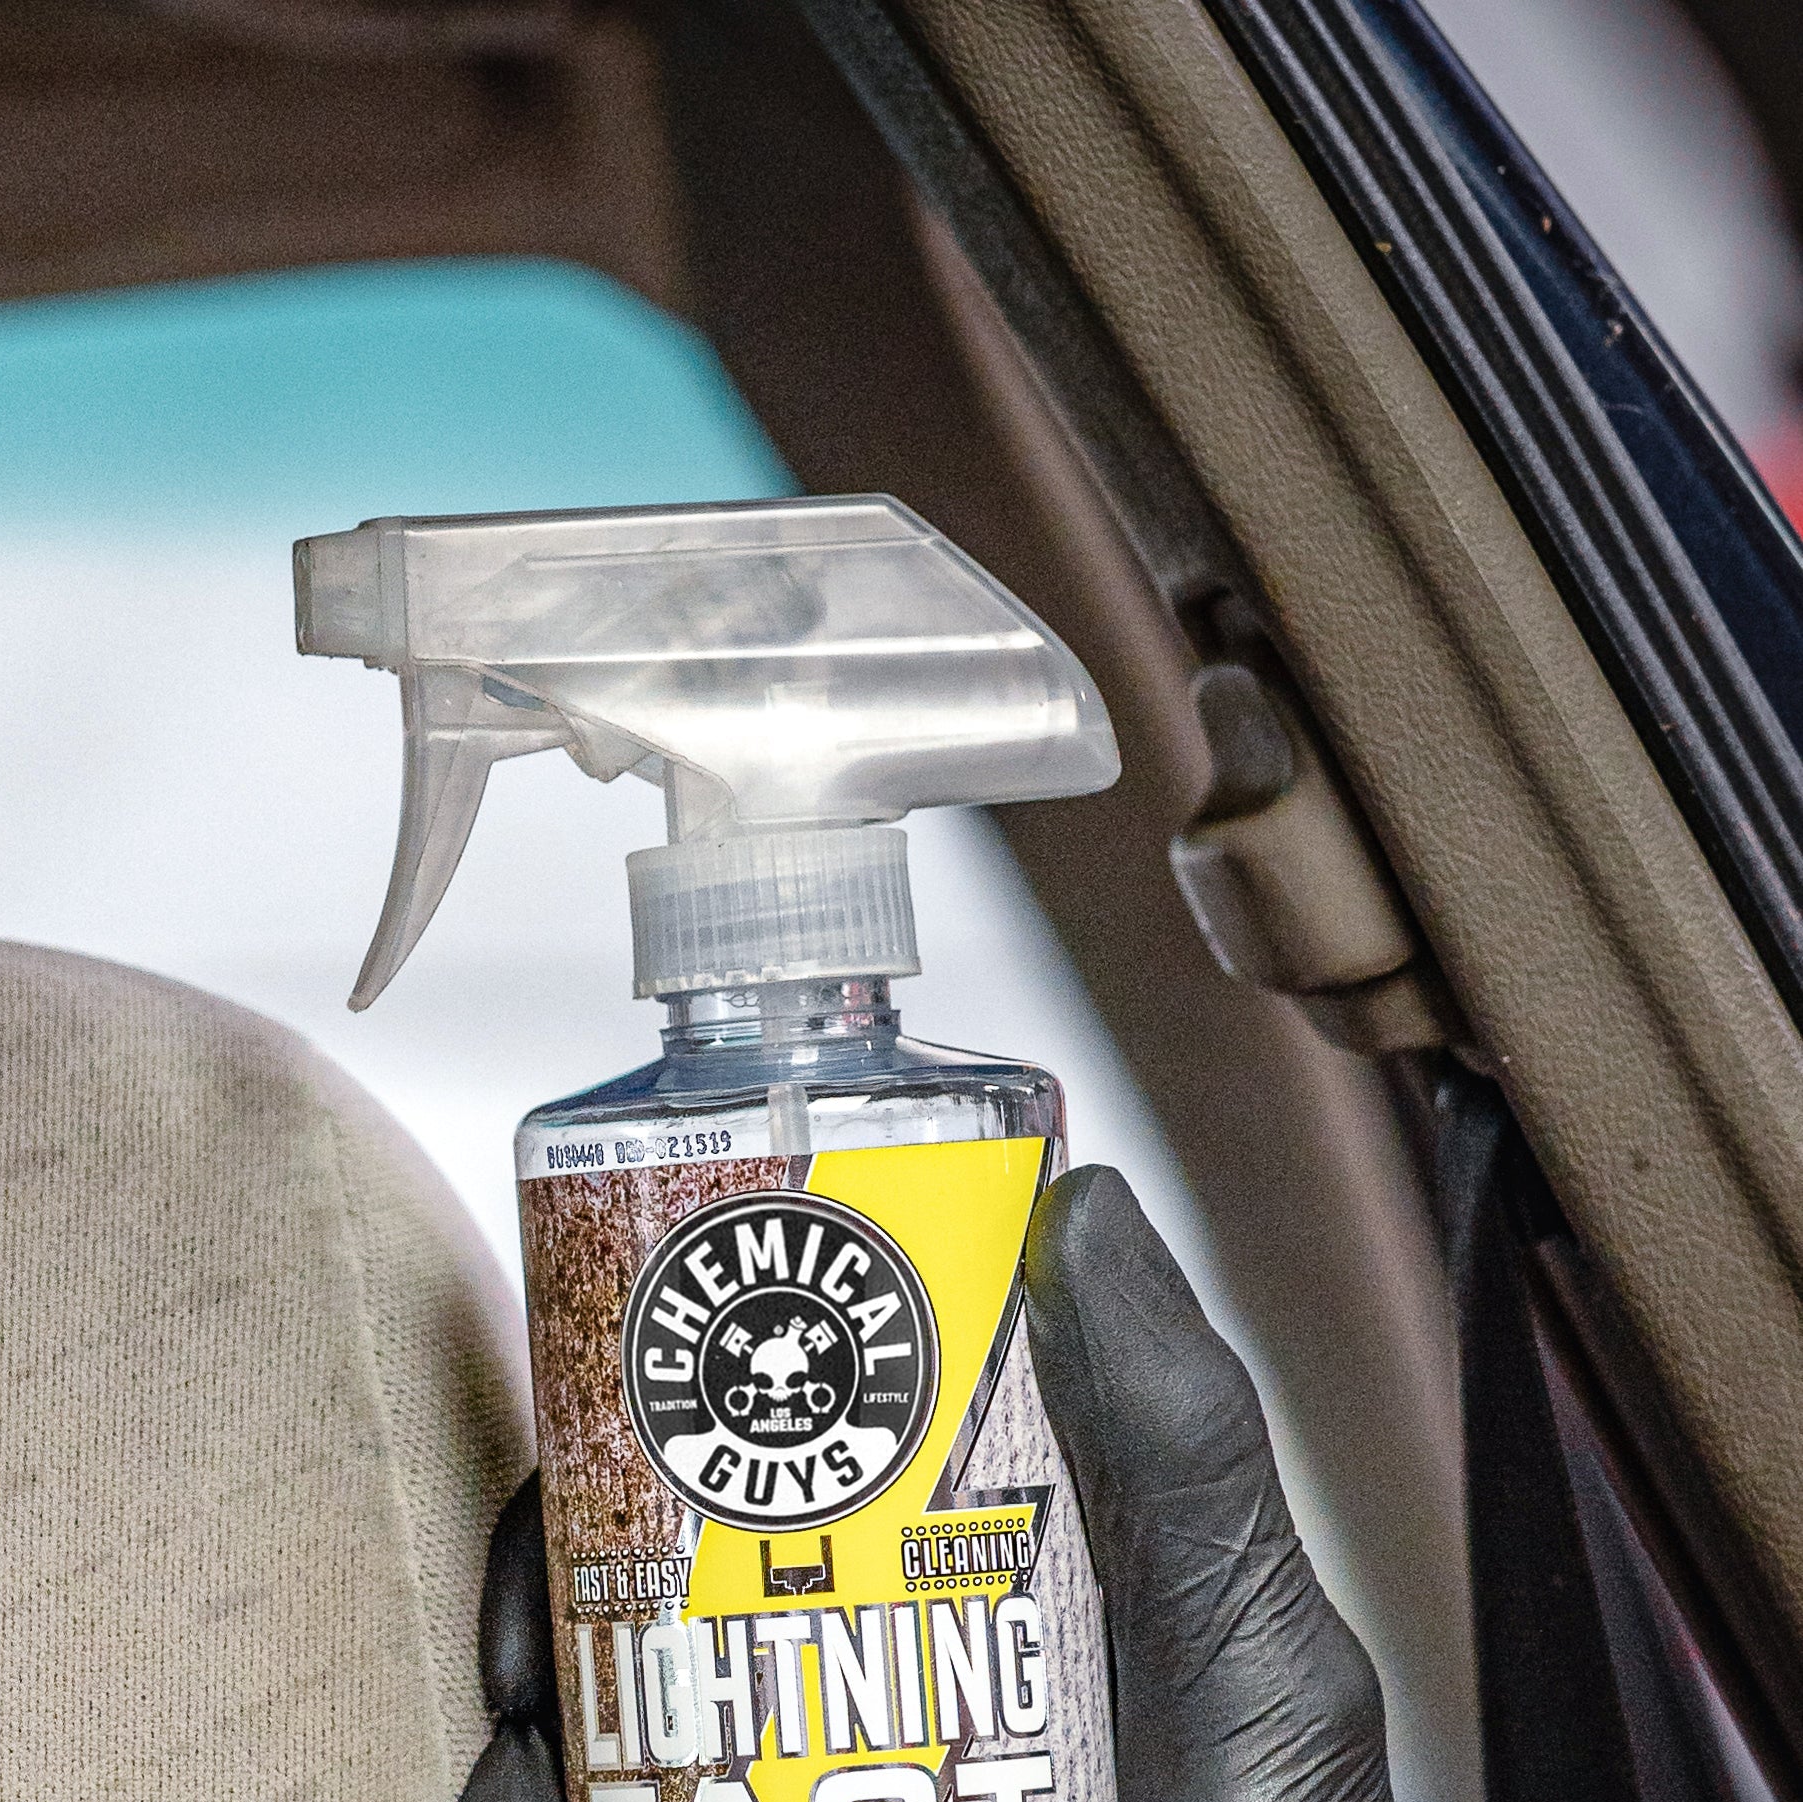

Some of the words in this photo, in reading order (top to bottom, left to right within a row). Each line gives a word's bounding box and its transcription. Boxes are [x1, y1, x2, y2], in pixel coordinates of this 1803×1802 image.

[644, 1217, 912, 1383] CHEMICAL
[648, 1399, 698, 1412] TRADITION
[769, 1407, 792, 1420] LOS
[862, 1392, 909, 1404] LIFESTYLE
[750, 1418, 813, 1433] ANGELES
[698, 1439, 864, 1507] GUYS
[573, 1563, 609, 1602] FAST
[615, 1562, 630, 1600] &
[634, 1557, 692, 1599] EASY
[901, 1530, 1031, 1580] CLEANING
[576, 1592, 1048, 1771] LIGHTNING
